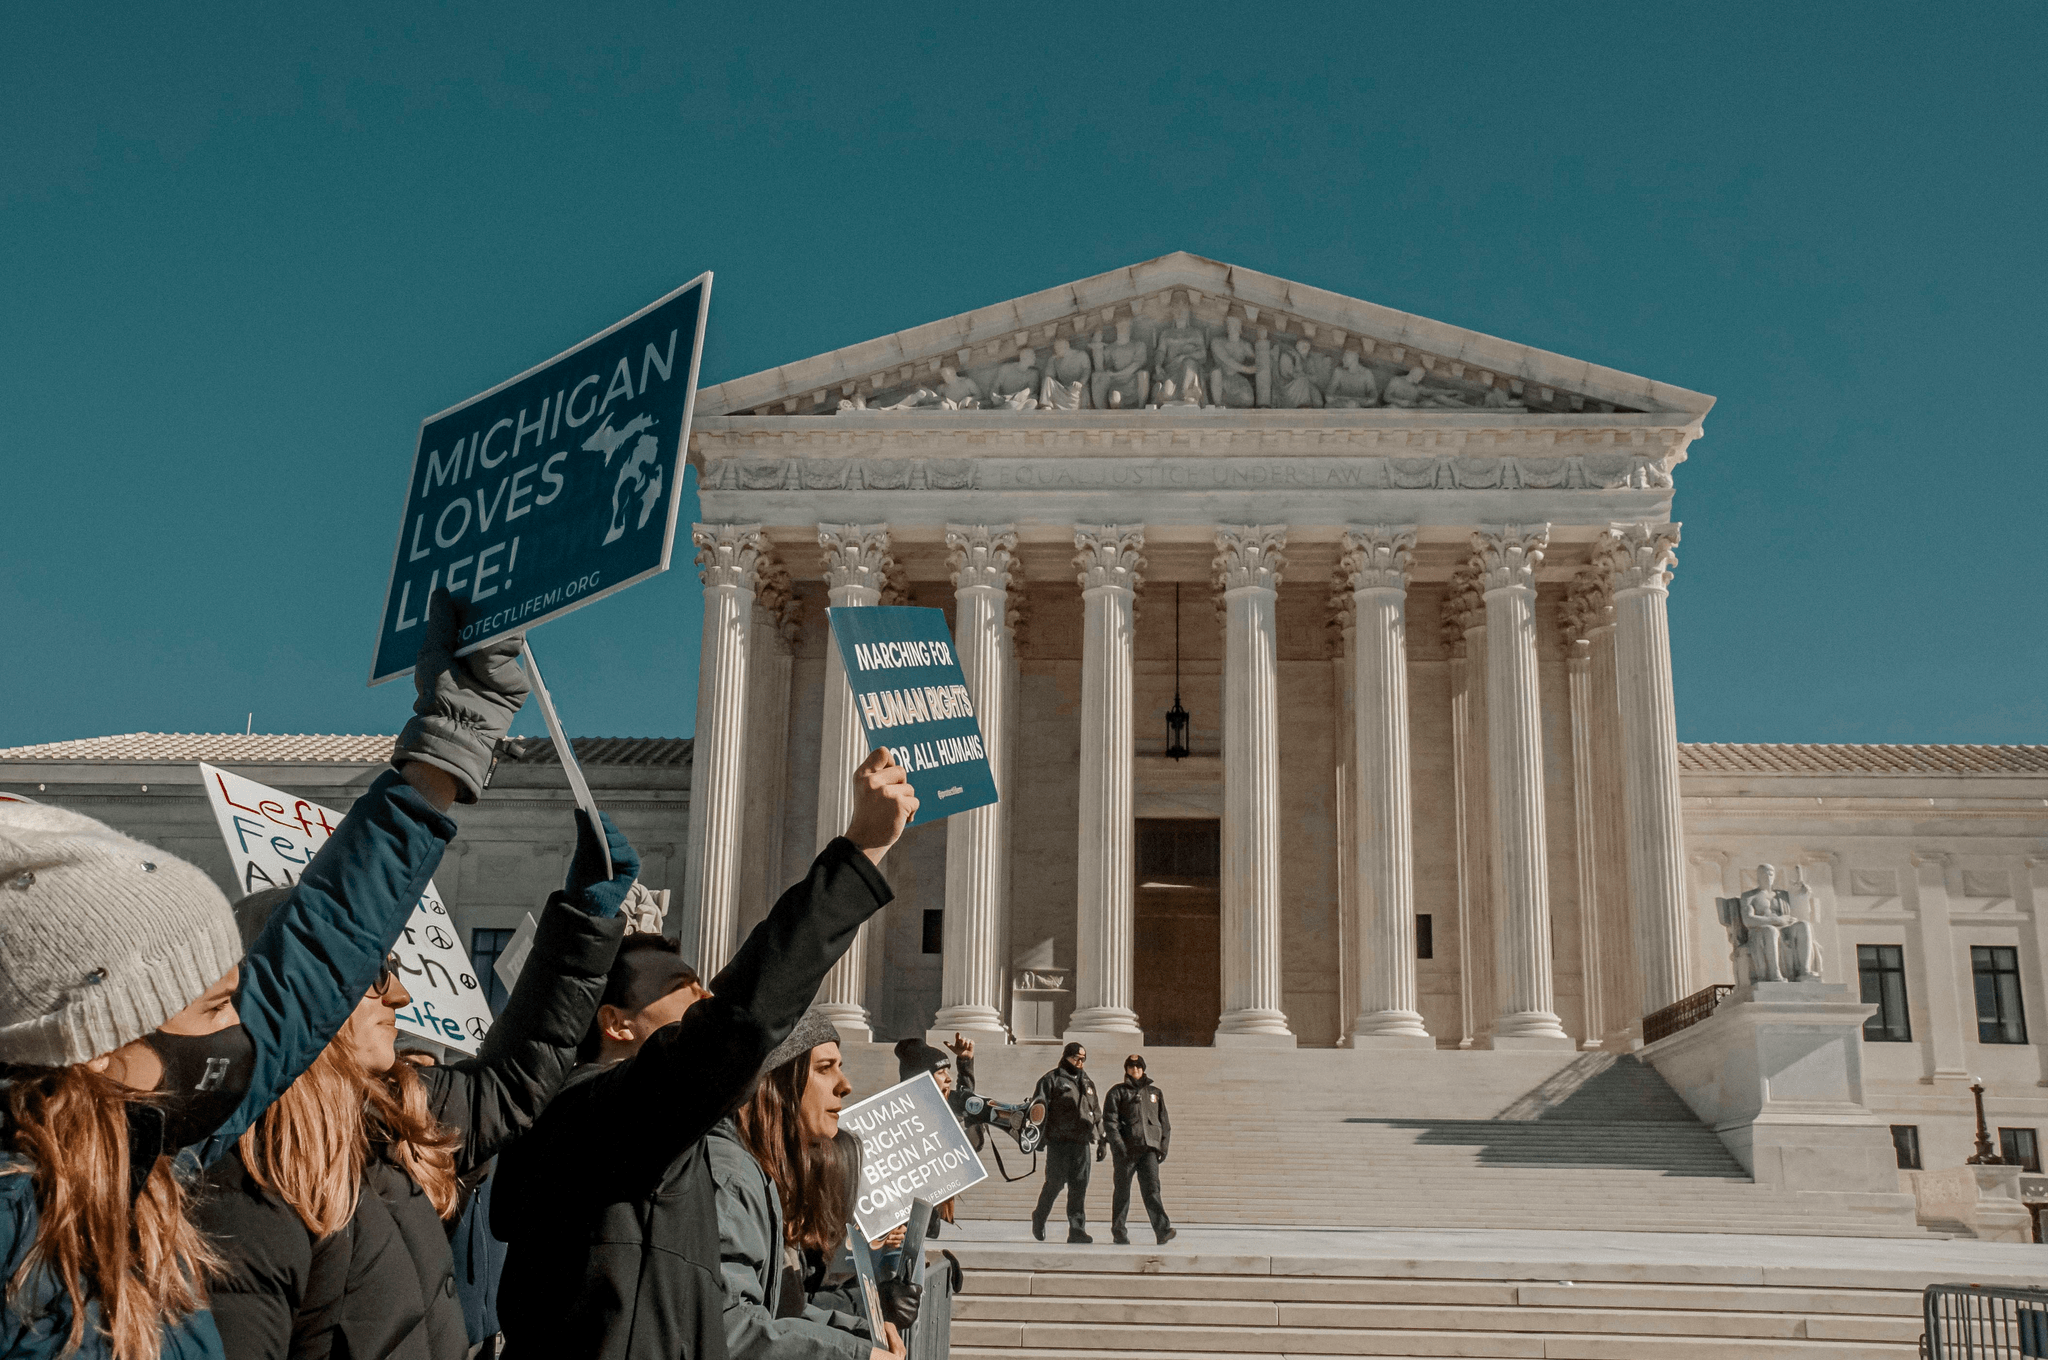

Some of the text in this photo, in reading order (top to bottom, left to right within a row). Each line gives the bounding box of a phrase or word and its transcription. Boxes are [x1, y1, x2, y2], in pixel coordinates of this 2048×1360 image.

[422, 329, 677, 497] MICHIGAN
[1000, 466, 1363, 485] EQUAL JUSTICE UNDER LAW
[409, 452, 568, 562] LOVES
[395, 536, 520, 632] LIFE!
[458, 570, 601, 643] OTECTLIFEMI.ORG
[854, 641, 953, 671] MARCHING FOR
[859, 685, 974, 730] HUMAN RIGHTS
[889, 734, 984, 773] OR ALL HUMANS
[215, 772, 336, 838] Left
[194, 1057, 231, 1091] H
[846, 1093, 916, 1135] HUMAN
[863, 1115, 925, 1159] RIGHTS
[857, 1145, 971, 1215] CONCEPTION
[863, 1131, 943, 1185] BEGIN AT
